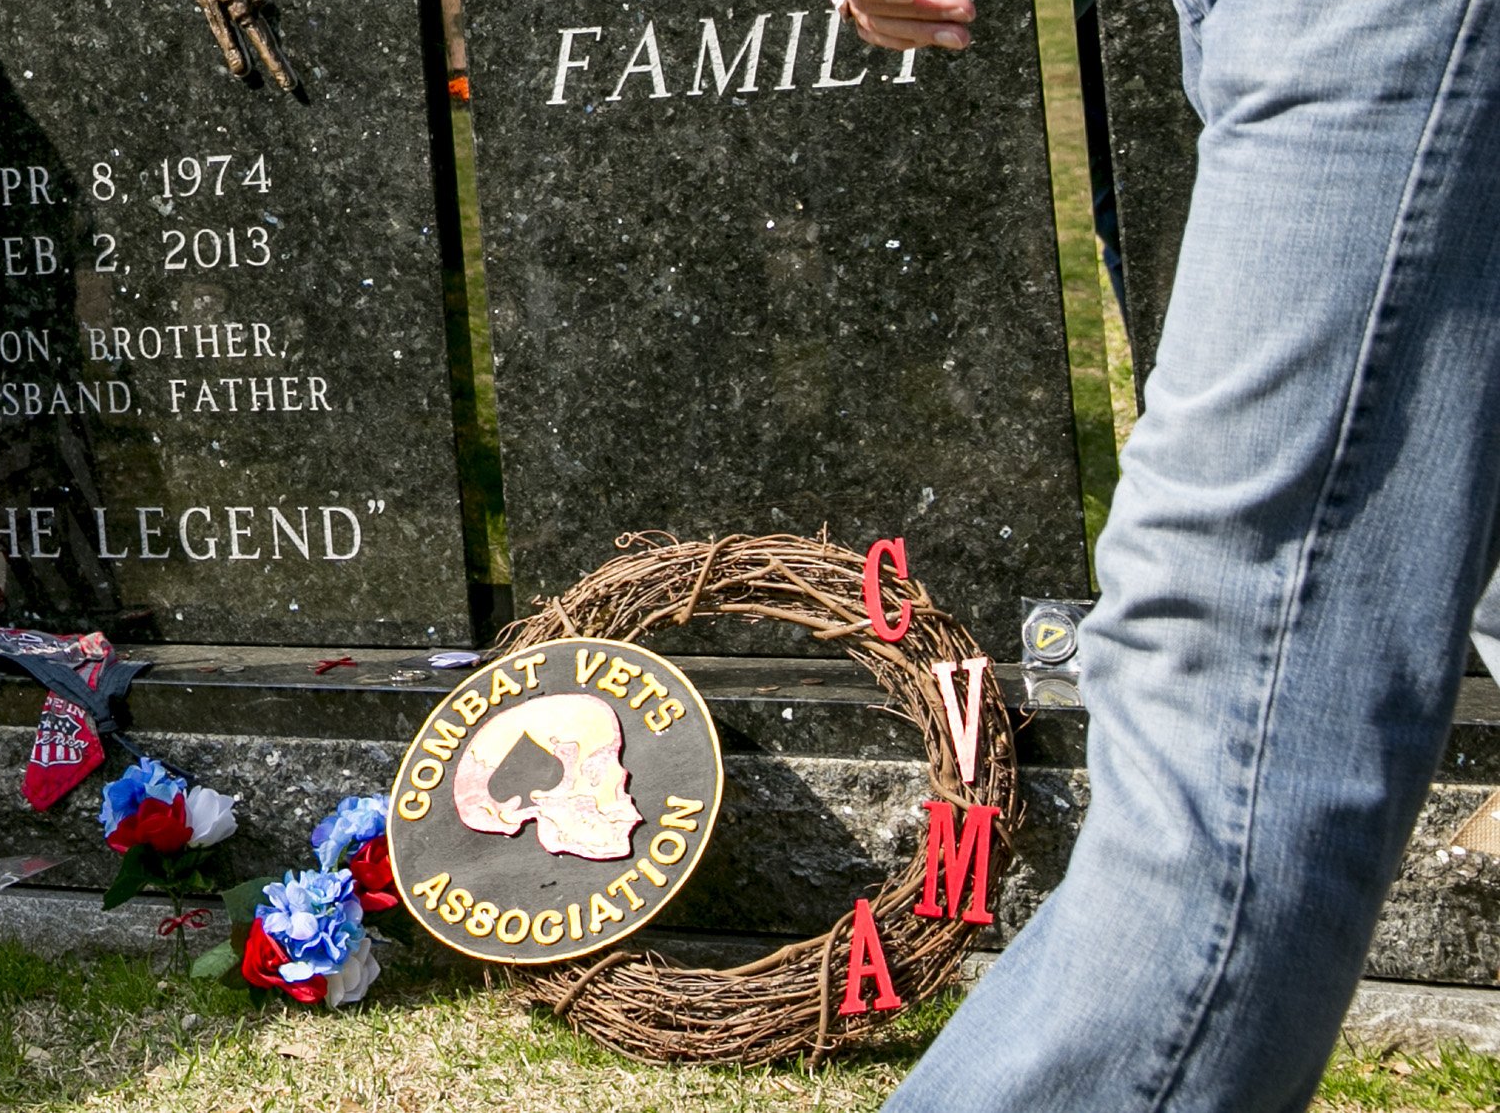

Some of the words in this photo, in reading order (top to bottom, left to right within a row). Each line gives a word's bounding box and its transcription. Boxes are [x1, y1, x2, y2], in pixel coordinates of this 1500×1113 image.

[91, 161, 129, 204] 8,
[161, 154, 272, 198] 1974
[94, 233, 131, 275] 2,
[161, 226, 272, 270] 2013
[89, 322, 288, 361] BROTHER,
[169, 376, 332, 413] FATHER
[398, 652, 546, 821] COMBAT
[576, 648, 686, 735] VETS
[412, 795, 704, 945] ASSOCIATION
